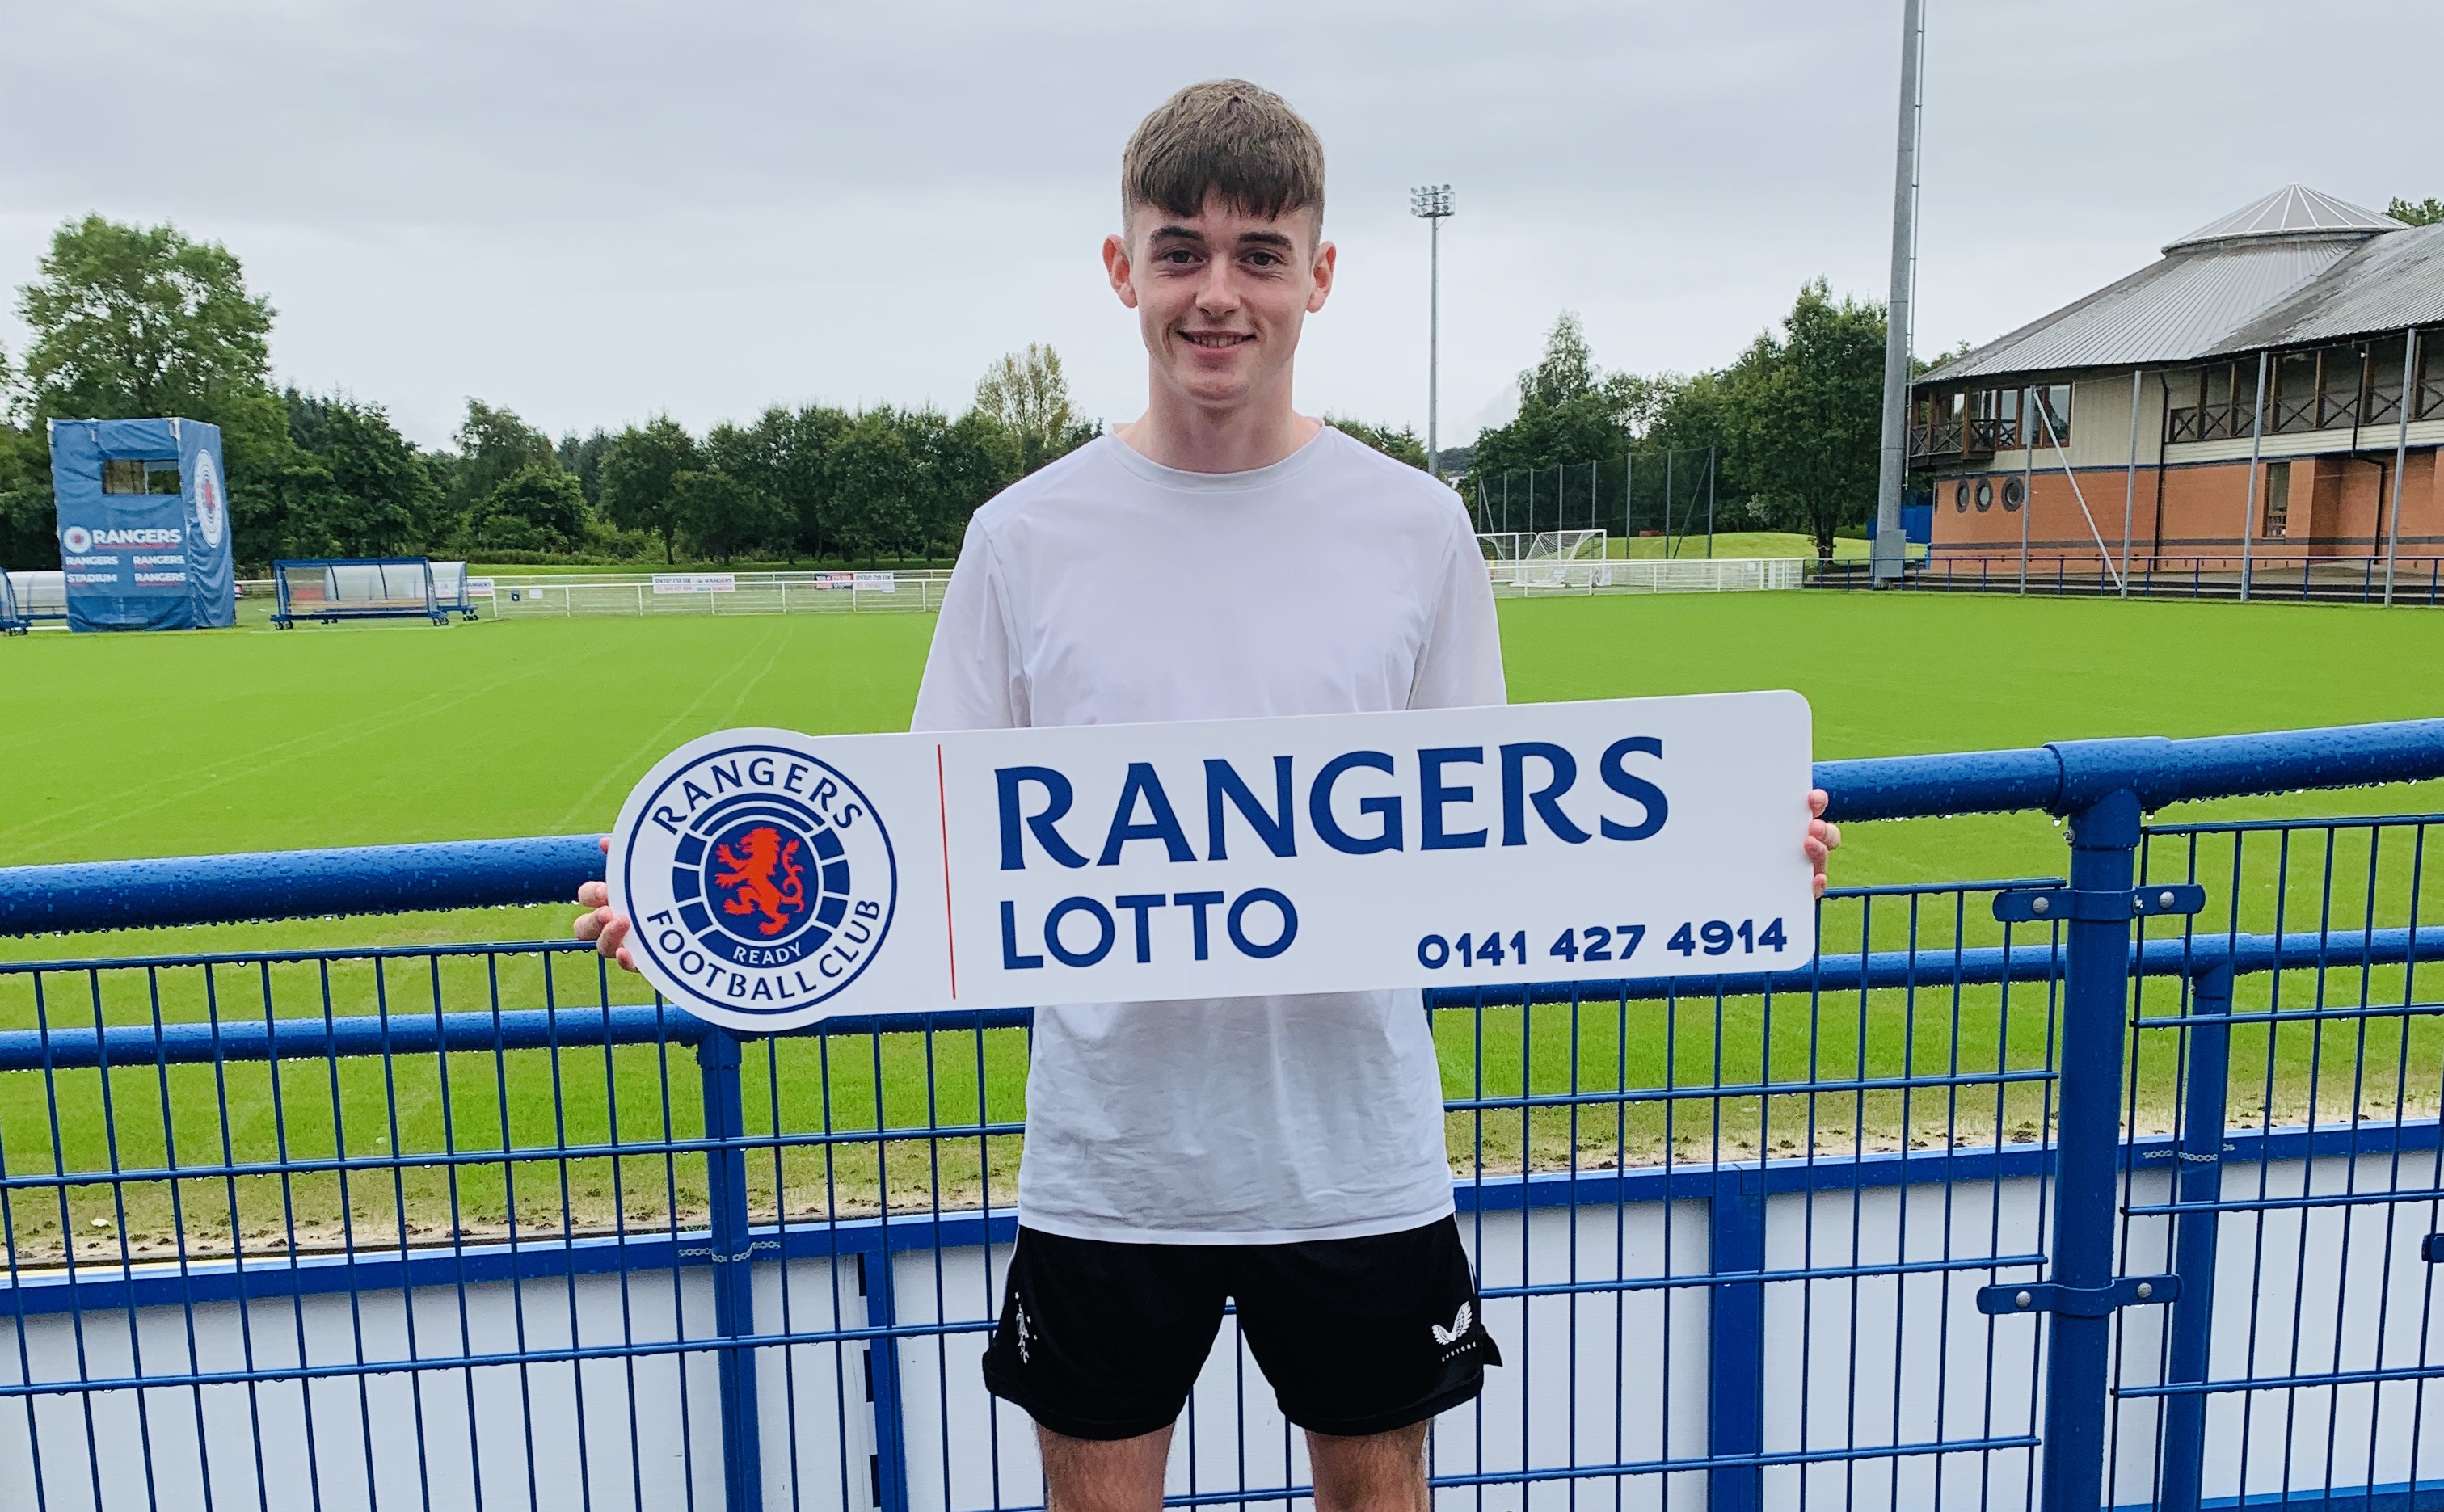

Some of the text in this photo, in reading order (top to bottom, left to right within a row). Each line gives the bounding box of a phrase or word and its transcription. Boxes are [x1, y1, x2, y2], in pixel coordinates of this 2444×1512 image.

[92, 529, 183, 544] RANGERS
[65, 555, 119, 566] RANGERS
[133, 555, 185, 565] RANGERS
[67, 573, 118, 583] STADIUM
[134, 572, 186, 582] RANGERS
[652, 758, 862, 835] RANGERS
[994, 736, 1668, 870] RANGERS
[1001, 888, 1298, 970] LOTTO
[647, 900, 880, 1000] FOOTBALL CLUB
[733, 942, 802, 965] READY
[1418, 918, 1788, 969] 0141 427 4914
